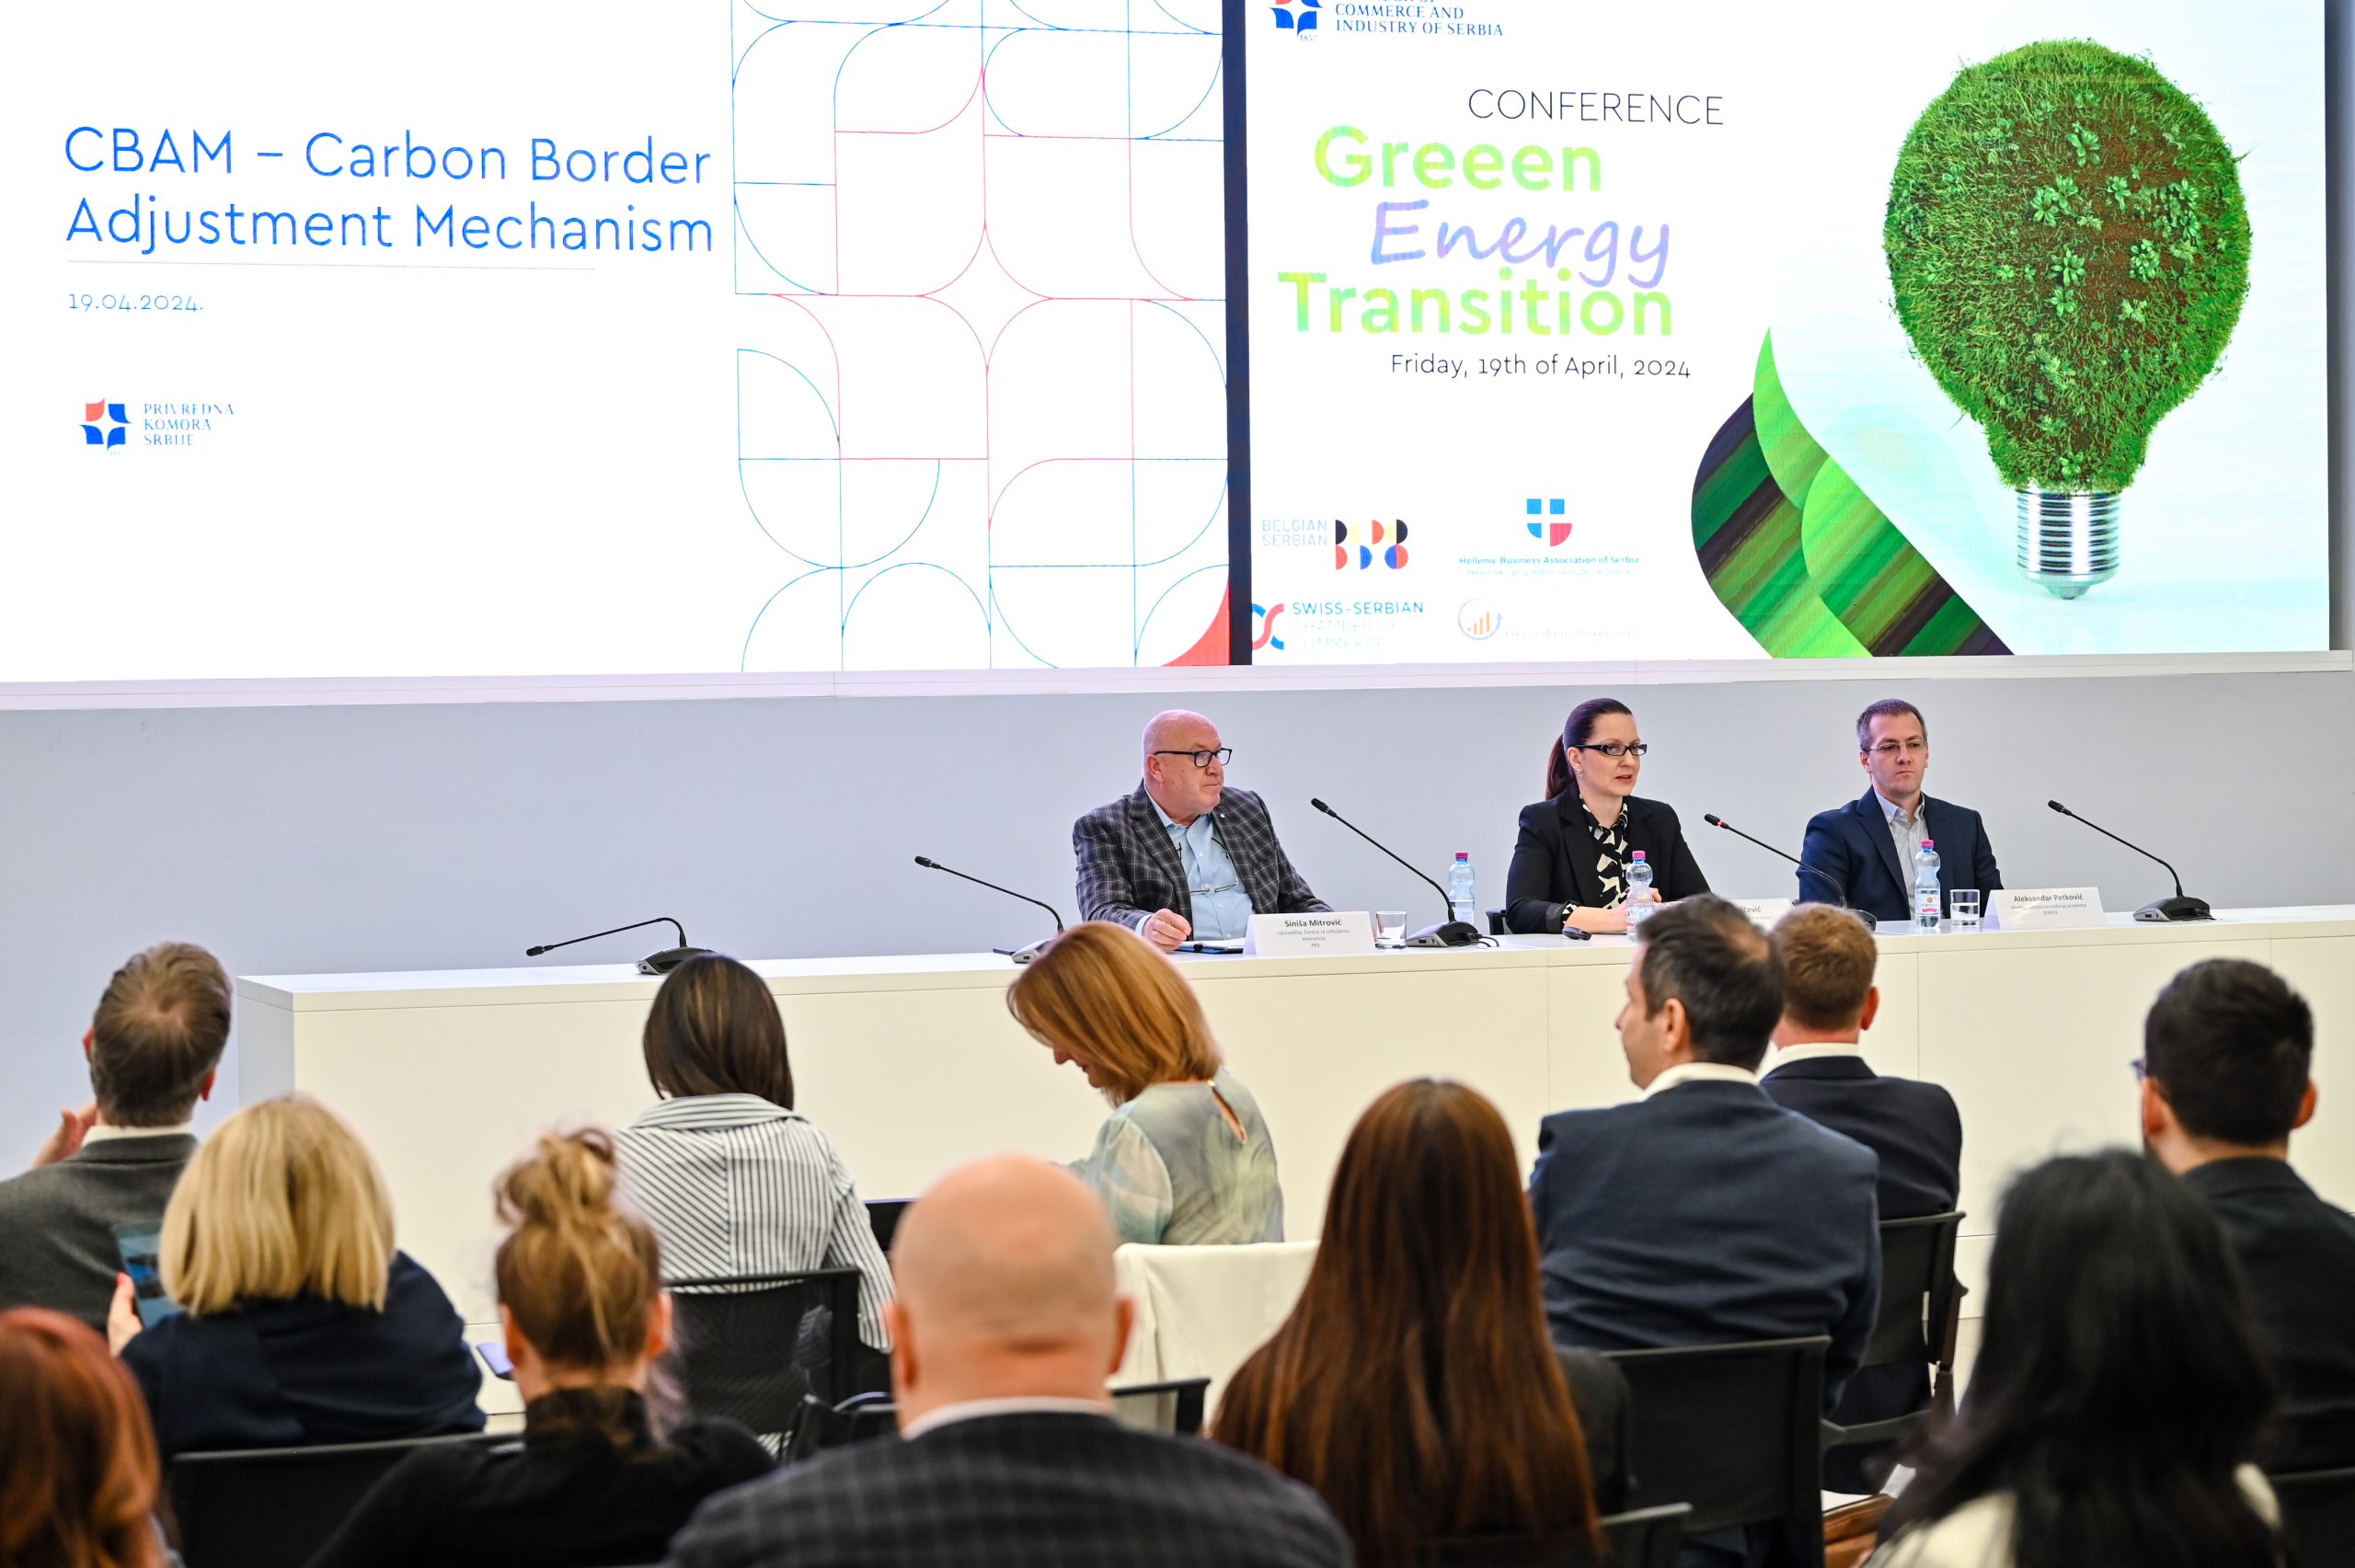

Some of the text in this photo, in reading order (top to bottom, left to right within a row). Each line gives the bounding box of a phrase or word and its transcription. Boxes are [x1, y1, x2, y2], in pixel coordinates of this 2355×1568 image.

[1336, 4, 1464, 18] COMMERCE AND
[1337, 19, 1502, 36] INDUSTRY OF SERBIA
[1469, 89, 1723, 125] CONFERENCE
[65, 126, 232, 174] CBAM
[306, 130, 506, 180] Carbon
[532, 135, 711, 184] Border
[1315, 125, 1601, 191] Greeen
[66, 193, 712, 255] Adjustment Mechanism
[1370, 199, 1670, 289] Energy
[69, 294, 202, 313] 19.04.2024.
[1277, 267, 1672, 336] Transition
[1393, 353, 1691, 379] Friday, 19th of April, 2024
[144, 403, 234, 415] PRIVREDNA
[143, 418, 211, 430] KOMORA
[144, 434, 191, 446] SRBIJE
[1261, 519, 1327, 533] BELGIAN
[1262, 533, 1327, 546] SERBIAN
[1459, 555, 1639, 566] Hellenic Business Association of Serbia
[2053, 893, 2084, 901] Petković
[1309, 919, 1342, 927] Mitrović
